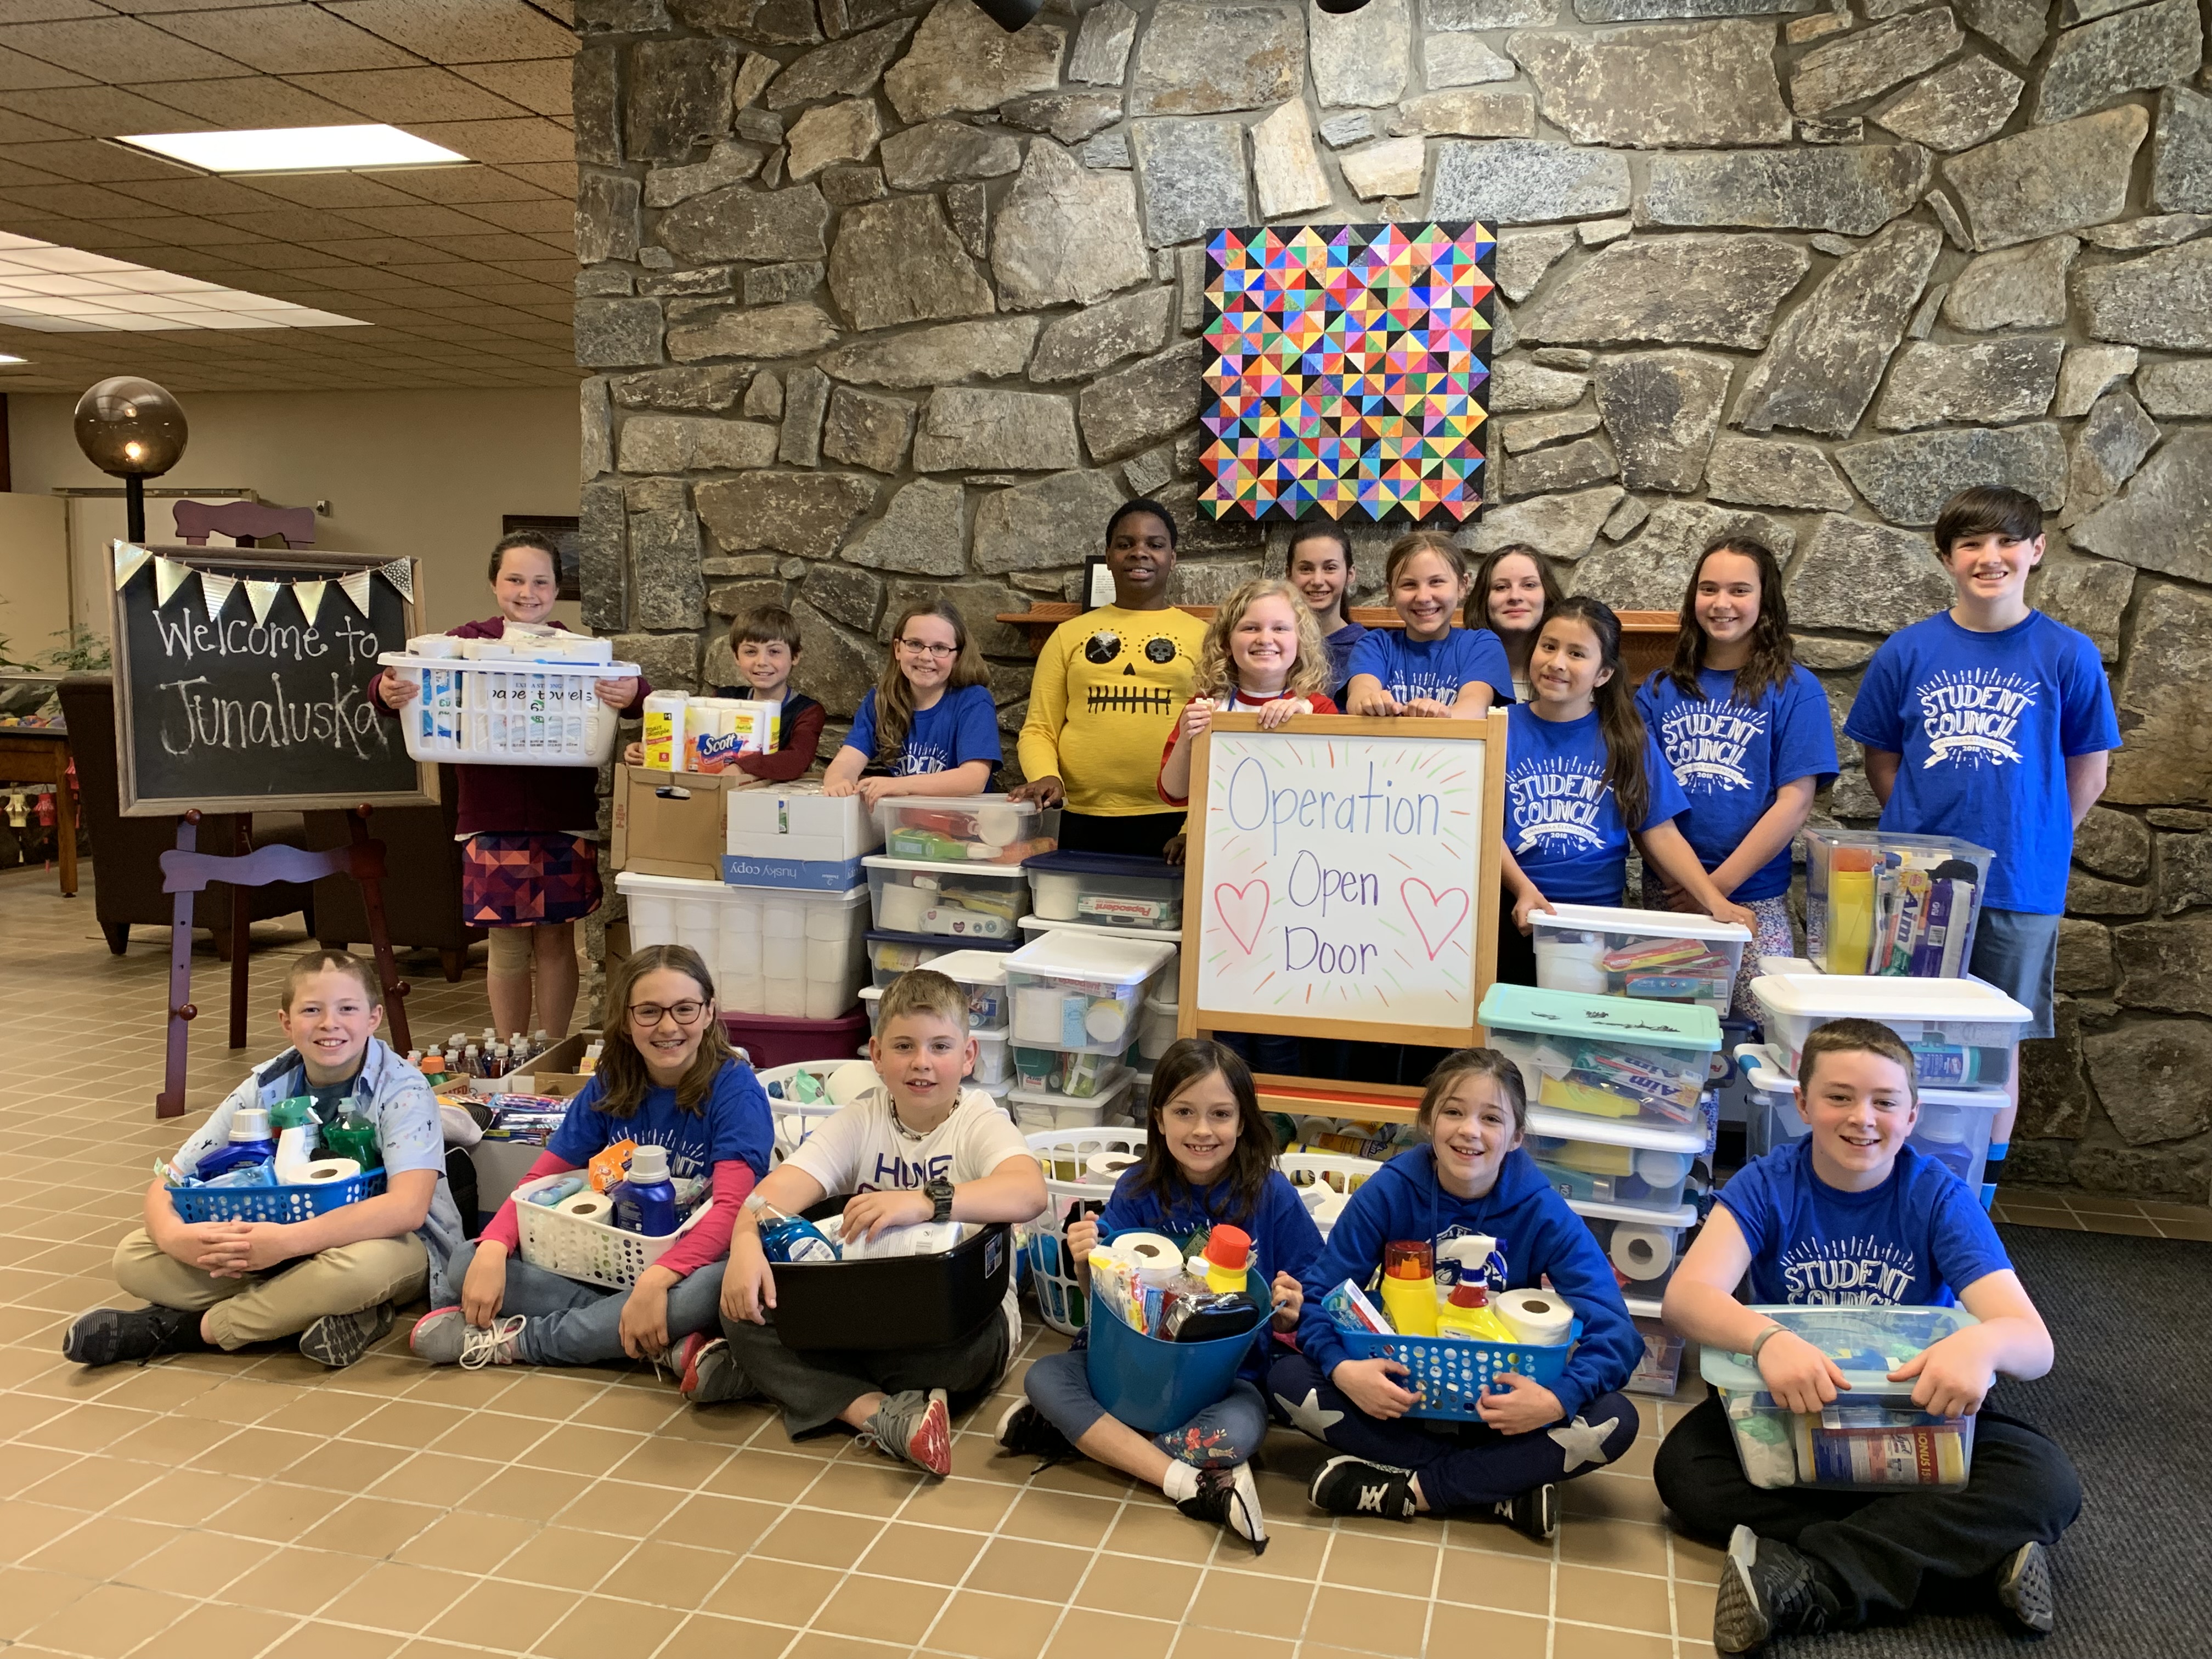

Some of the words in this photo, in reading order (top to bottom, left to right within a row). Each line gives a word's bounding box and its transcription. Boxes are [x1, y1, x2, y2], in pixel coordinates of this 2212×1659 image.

[153, 607, 328, 661] Welcome
[335, 616, 379, 664] to
[156, 672, 388, 760] Junaluska
[1920, 684, 2036, 719] STUDENT
[703, 733, 736, 755] Scott
[1662, 714, 1764, 747] STUDENT
[1923, 710, 2018, 746] COUNCIL
[1665, 738, 1747, 773] COUNCIL
[1509, 774, 1614, 806] STUDENT
[1696, 771, 1714, 780] 2018
[1228, 756, 1440, 856] Operation
[1513, 799, 1600, 833] COUNCIL
[729, 861, 760, 874] copy
[761, 865, 797, 879] husky
[1289, 849, 1379, 917] Open
[1094, 903, 1152, 917] Pepsodent
[1897, 887, 1919, 943] Aim
[1284, 926, 1378, 975] Door
[1629, 1075, 1682, 1097] Aim
[1784, 1259, 1916, 1301] STUDENT
